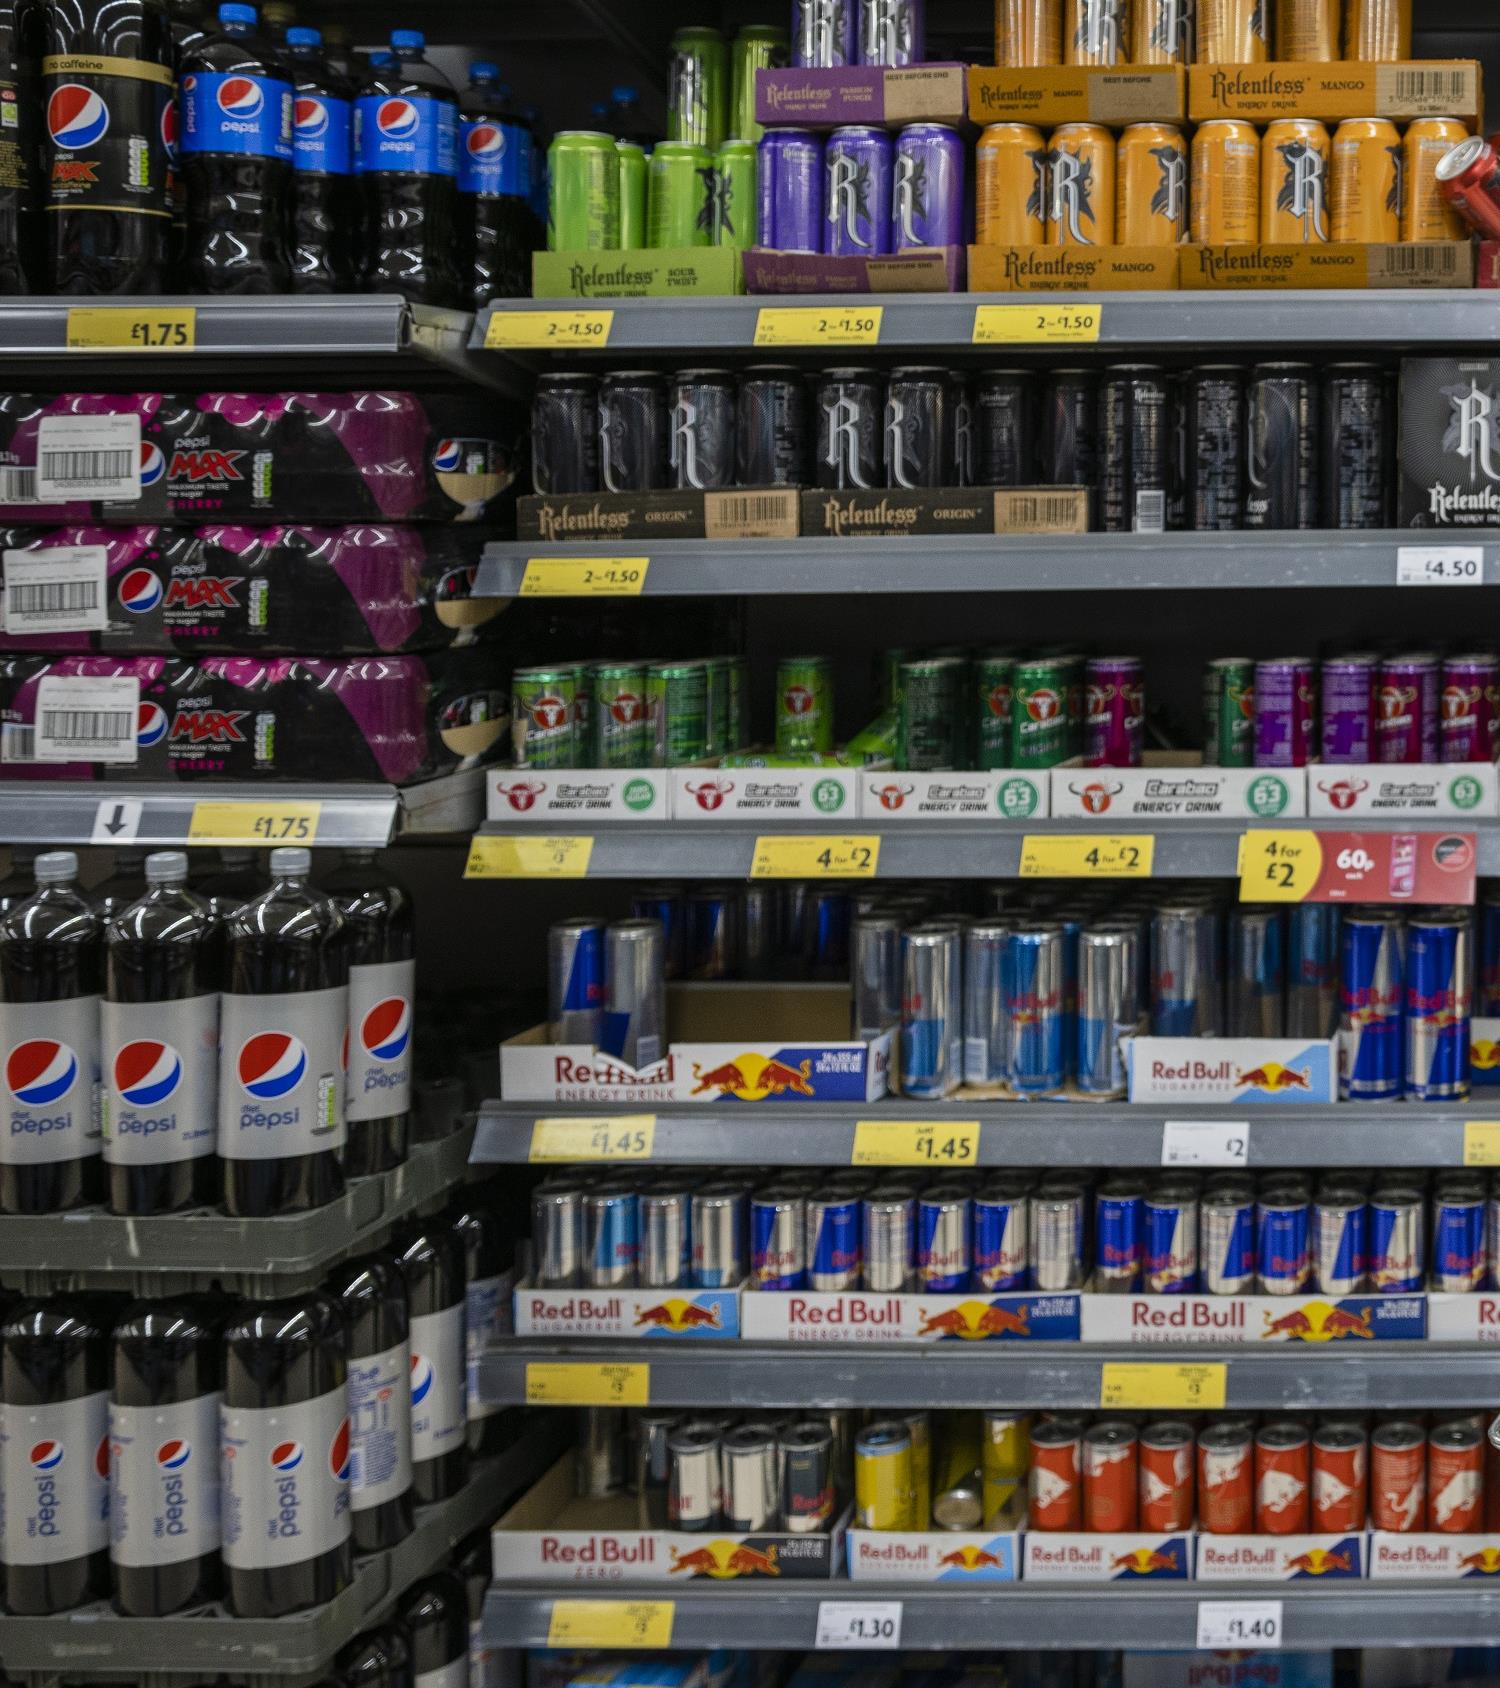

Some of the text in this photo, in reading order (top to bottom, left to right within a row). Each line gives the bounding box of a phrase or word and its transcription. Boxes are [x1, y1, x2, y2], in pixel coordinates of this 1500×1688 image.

[60, 60, 103, 69] caffeine
[980, 82, 1045, 109] Relentless
[1210, 68, 1306, 110] Relentless
[1321, 81, 1365, 91] MANGO
[221, 122, 259, 134] pepsi
[380, 142, 415, 152] pepsi
[1002, 248, 1097, 290] Relentless
[1111, 263, 1155, 273] MANGO
[1199, 246, 1297, 284] Relentless
[1310, 256, 1355, 266] MANGO
[569, 261, 653, 296] Relentless
[569, 323, 603, 336] £1.50
[839, 318, 874, 332] £1.50
[1057, 316, 1093, 330] £1.50
[131, 323, 188, 346] £1.75
[174, 436, 211, 449] pepsi
[167, 450, 248, 481] MAX
[537, 501, 631, 540] Relentless
[645, 511, 689, 524] ORIGIN
[823, 498, 919, 536] Relentless
[933, 508, 978, 520] ORIGIN
[172, 563, 207, 576] pepsi
[605, 570, 639, 583] £1.50
[1425, 560, 1477, 578] £4.50
[162, 577, 246, 607] MAX
[177, 695, 212, 708] pepsi
[169, 711, 250, 742] MAX
[1003, 788, 1032, 806] 63
[1145, 780, 1220, 798] Carabao
[1253, 786, 1282, 804] 63
[1133, 801, 1223, 813] ENERGY DRINK
[254, 816, 311, 839] £1.75
[818, 849, 831, 867] 4
[851, 848, 871, 868] £2
[1084, 849, 1099, 867] 4
[1119, 848, 1140, 868] £2
[1265, 841, 1302, 857] 4 for
[1336, 849, 1375, 873] 60p
[1266, 862, 1295, 887] £2
[1152, 1060, 1230, 1079] Red Bull
[11, 1113, 72, 1137] pepsi
[118, 1114, 176, 1137] pepsi
[241, 1107, 300, 1130] pepsi
[592, 1132, 645, 1154] £1.45
[915, 1138, 971, 1160] £1.45
[1226, 1138, 1244, 1158] £2
[532, 1300, 621, 1319] Red Bull
[789, 1299, 902, 1324] Red Bull
[1132, 1302, 1246, 1328] Red Bull
[788, 1328, 902, 1340] ENERGY DRINK
[37, 1473, 61, 1538] pepsi
[165, 1472, 189, 1538] pepsi
[279, 1474, 302, 1539] pepsi
[540, 1538, 655, 1562] Red Bull
[859, 1544, 929, 1559] Red Bull
[1032, 1546, 1101, 1562] Red Bull
[1206, 1548, 1276, 1564] Red Bull
[1379, 1547, 1449, 1562] Red Bull
[574, 1568, 623, 1579] ZERO
[851, 1619, 894, 1638] £1.30
[1229, 1619, 1275, 1639] £1.40
